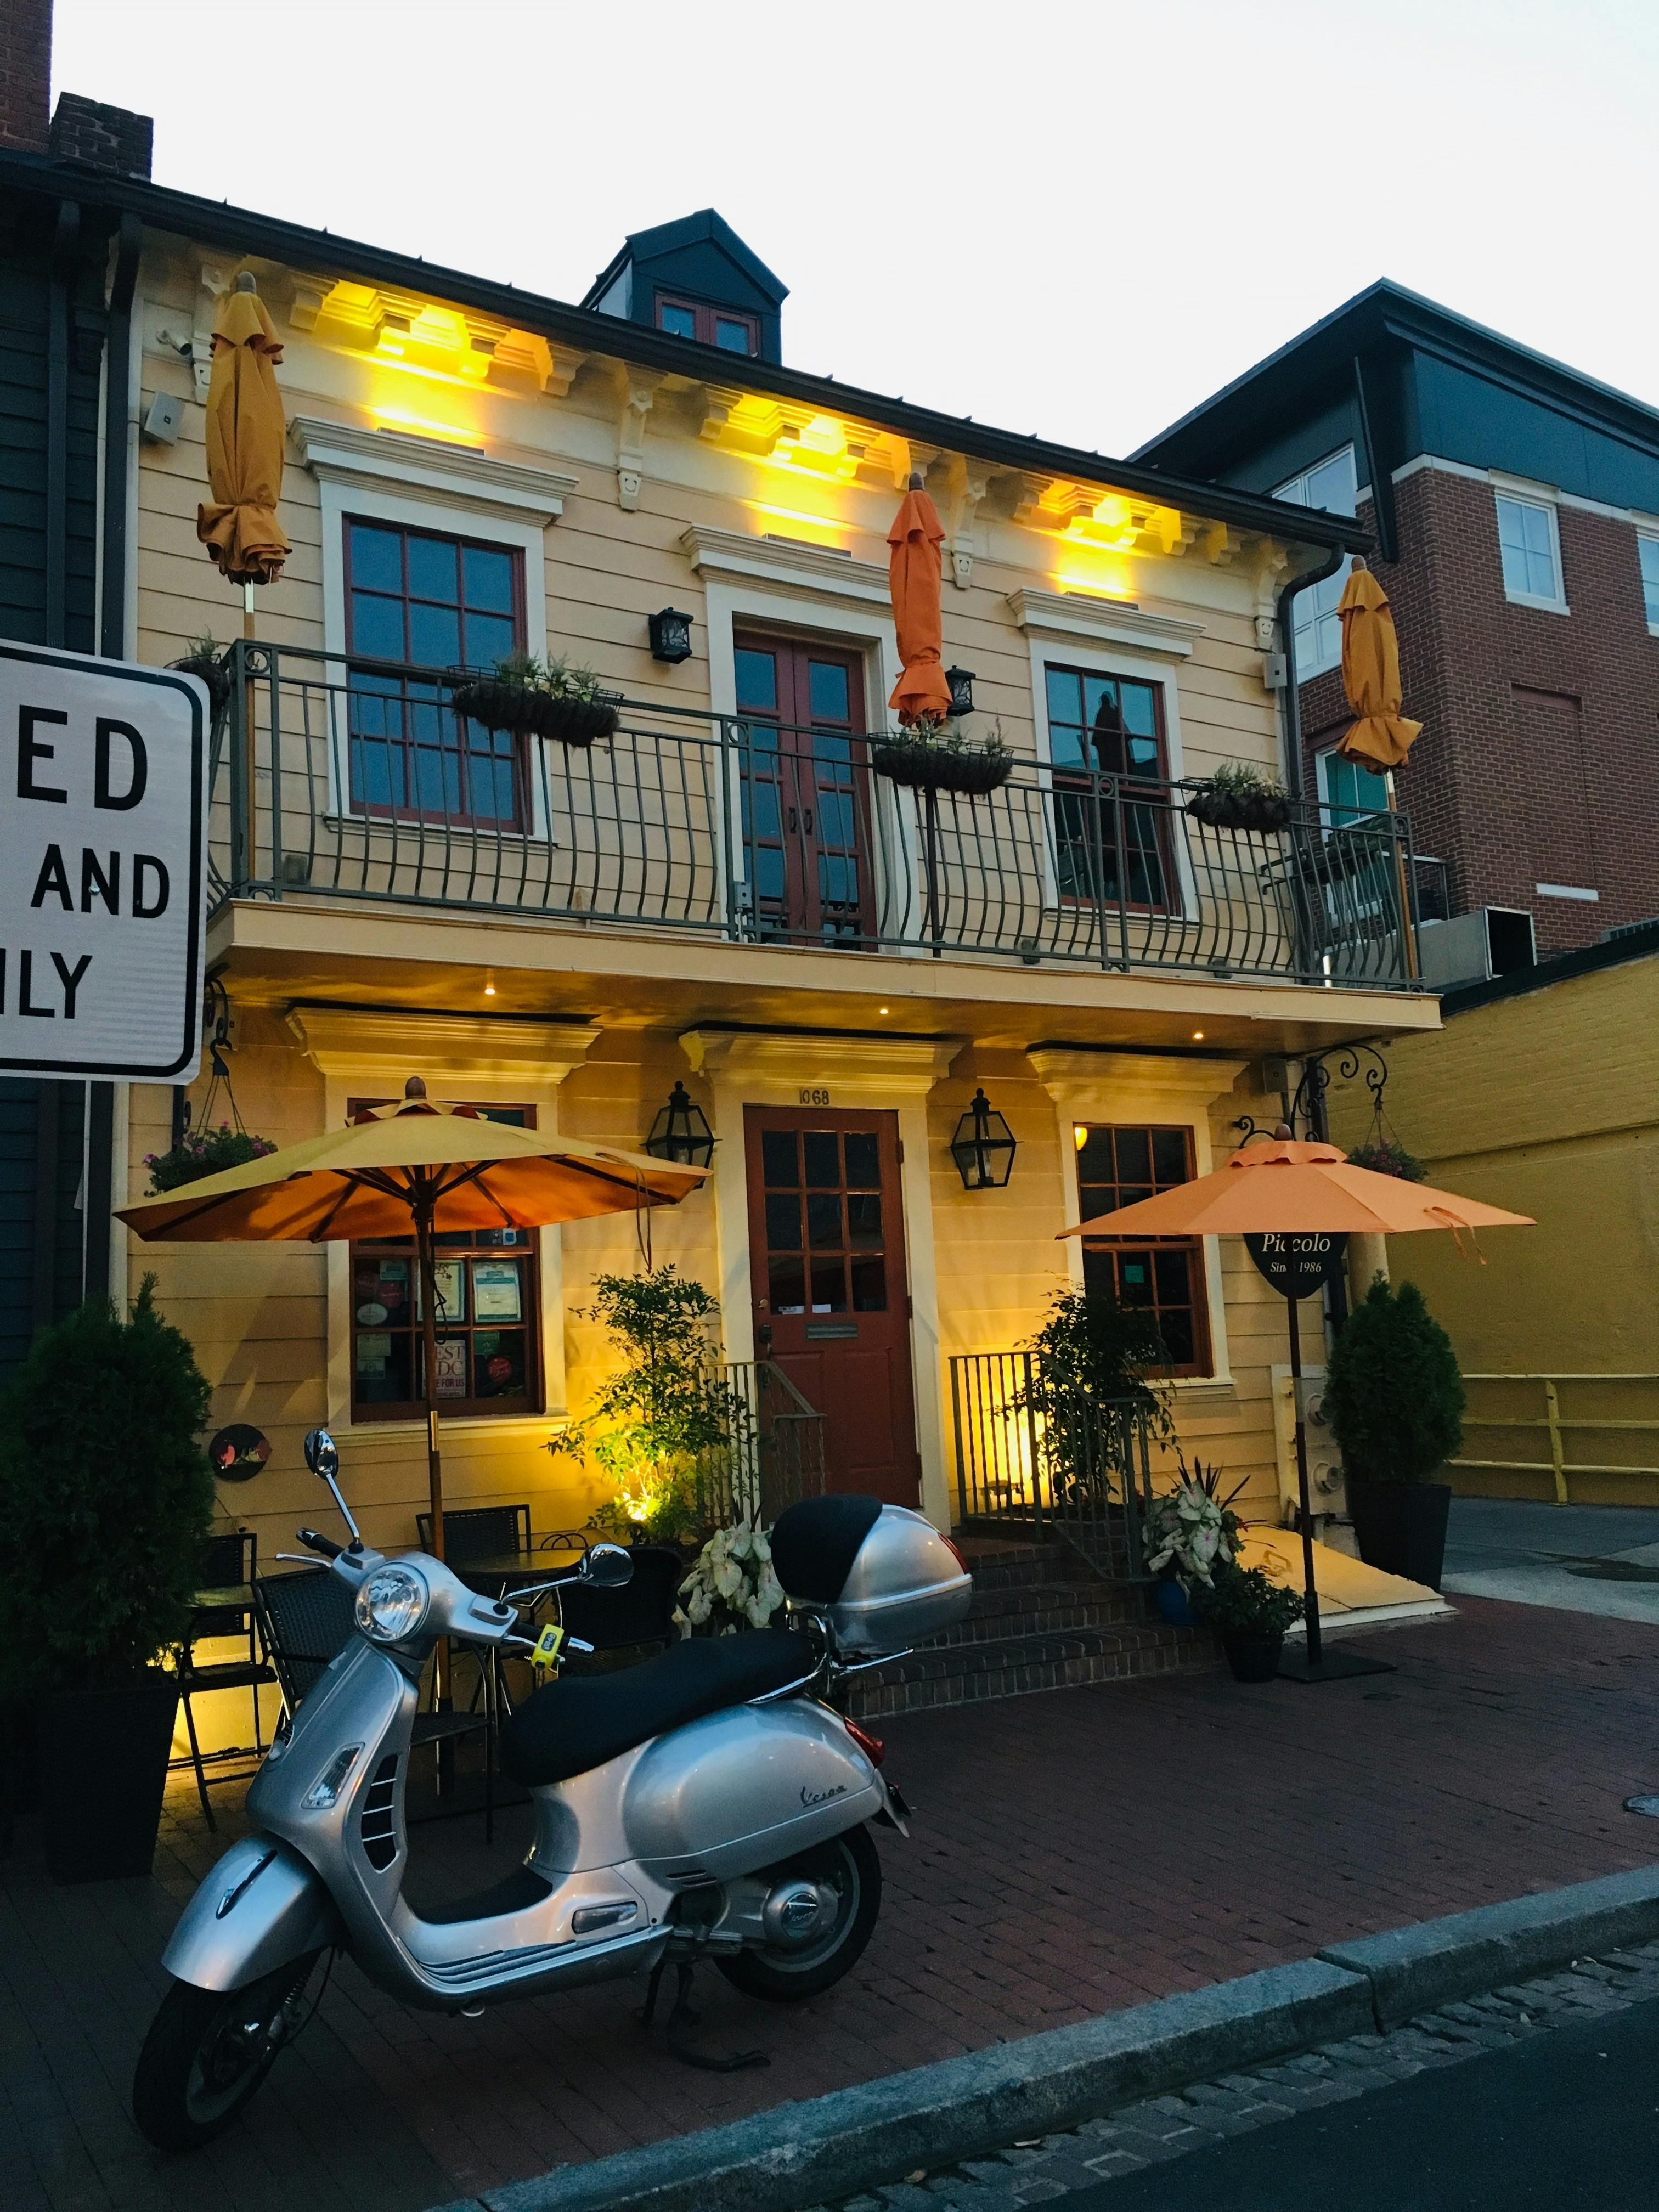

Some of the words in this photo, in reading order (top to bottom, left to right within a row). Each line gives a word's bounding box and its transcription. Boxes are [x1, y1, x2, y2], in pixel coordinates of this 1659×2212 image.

[17, 704, 148, 811] ED
[30, 844, 170, 918] AND
[0, 949, 93, 1019] LY
[799, 1089, 830, 1105] 1068
[1299, 1262, 1322, 1272] 1986
[455, 1378, 465, 1387] US
[800, 1786, 847, 1808] Vespa
